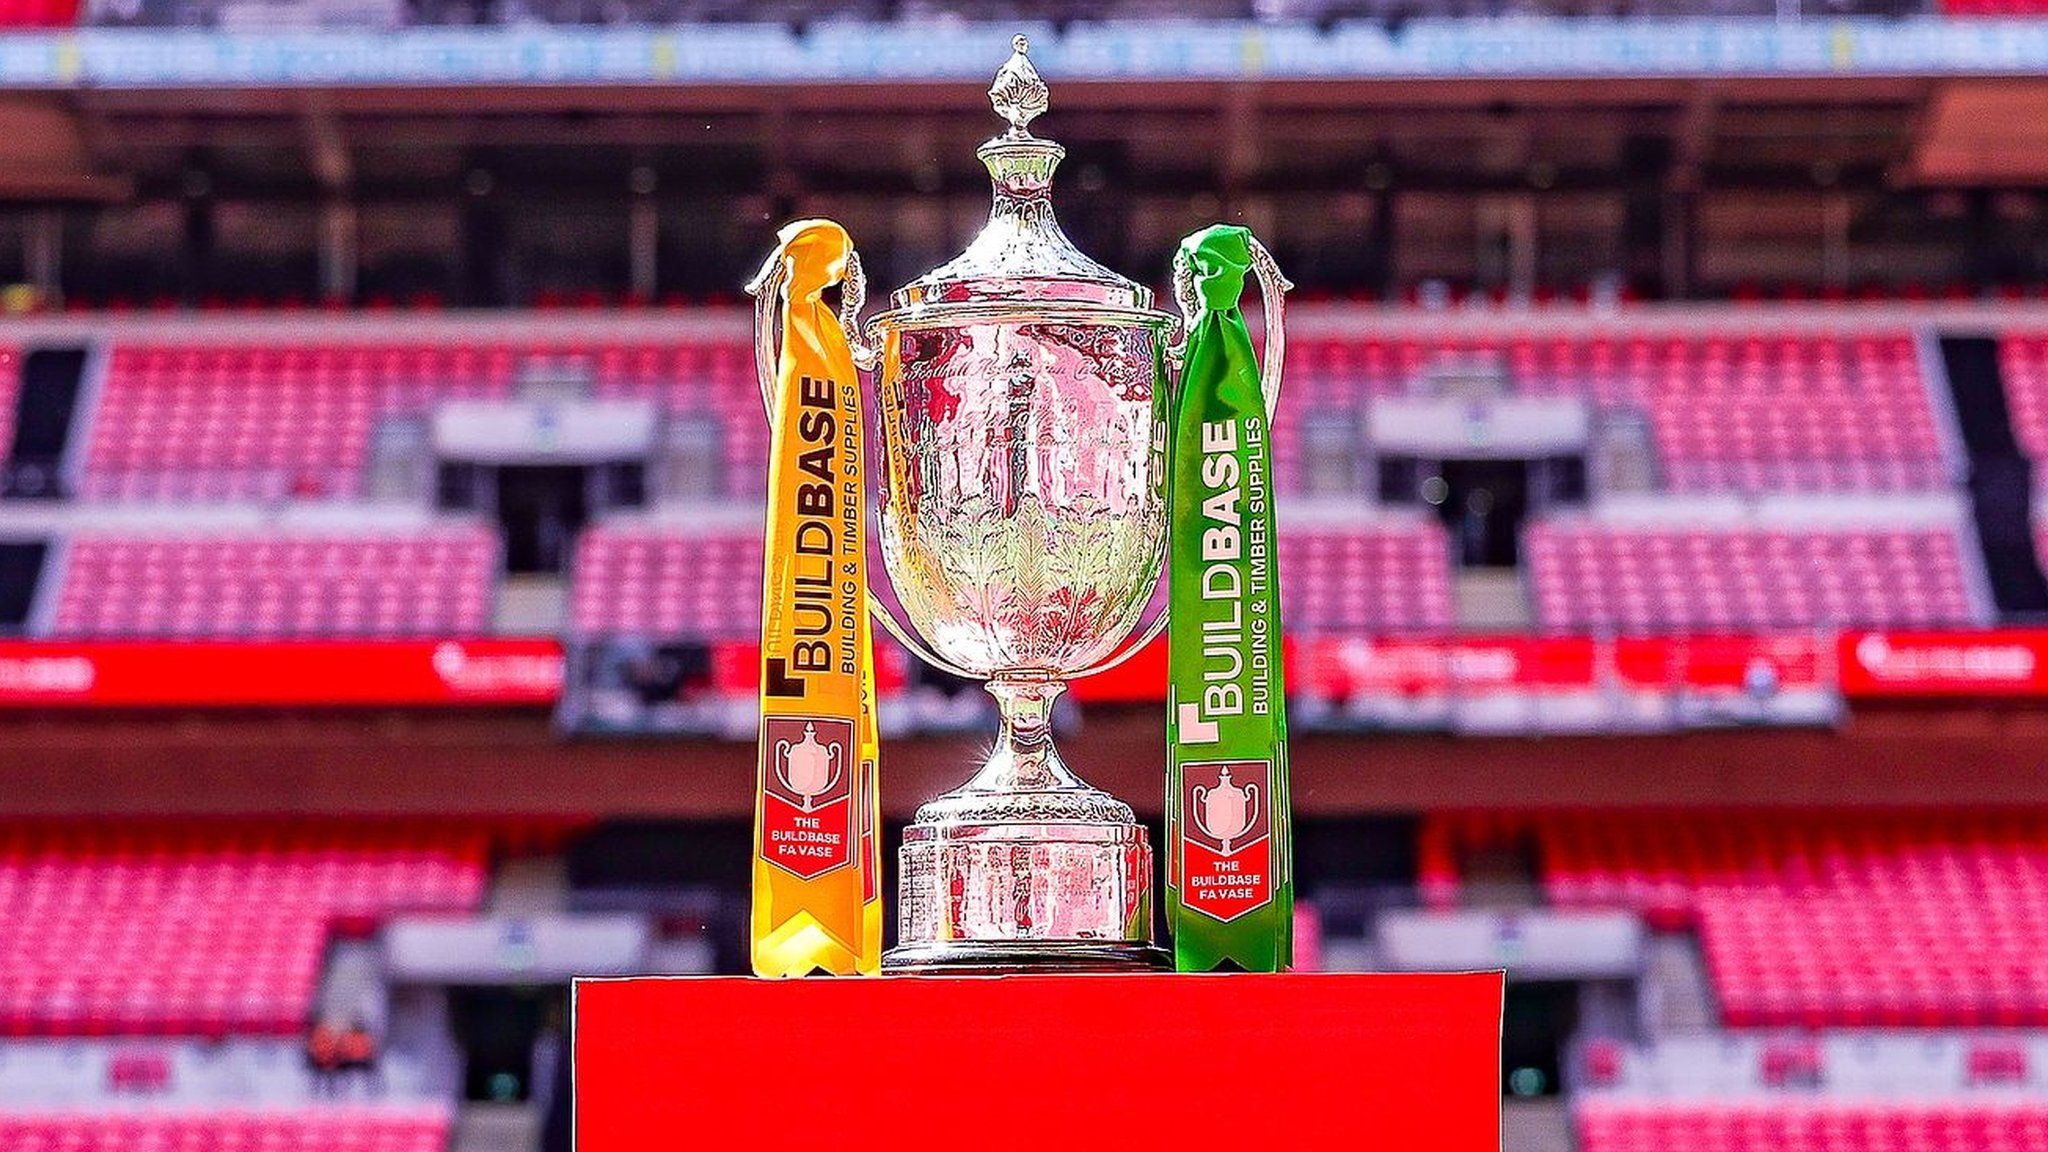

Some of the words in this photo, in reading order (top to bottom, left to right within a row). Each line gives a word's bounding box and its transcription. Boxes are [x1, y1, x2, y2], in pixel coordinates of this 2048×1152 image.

[842, 386, 857, 476] SUPPLIES
[1245, 417, 1265, 513] SUPPLIES
[793, 377, 836, 671] BUILDBASE
[842, 482, 857, 554] TIMBER
[842, 562, 857, 575] &
[1202, 419, 1243, 715] BUILDBASE
[1250, 518, 1266, 595] TIMBER
[842, 581, 857, 674] BUILDING
[1251, 599, 1267, 613] &
[1252, 618, 1268, 714] BUILDING
[771, 830, 840, 844] BUILDBASE
[794, 817, 820, 829] THE
[779, 845, 797, 855] FA
[799, 845, 833, 857] VASE
[1213, 861, 1240, 872] THE
[1191, 874, 1261, 887] BUILDBASE
[1200, 889, 1217, 899] FA
[1218, 888, 1254, 899] VASE
